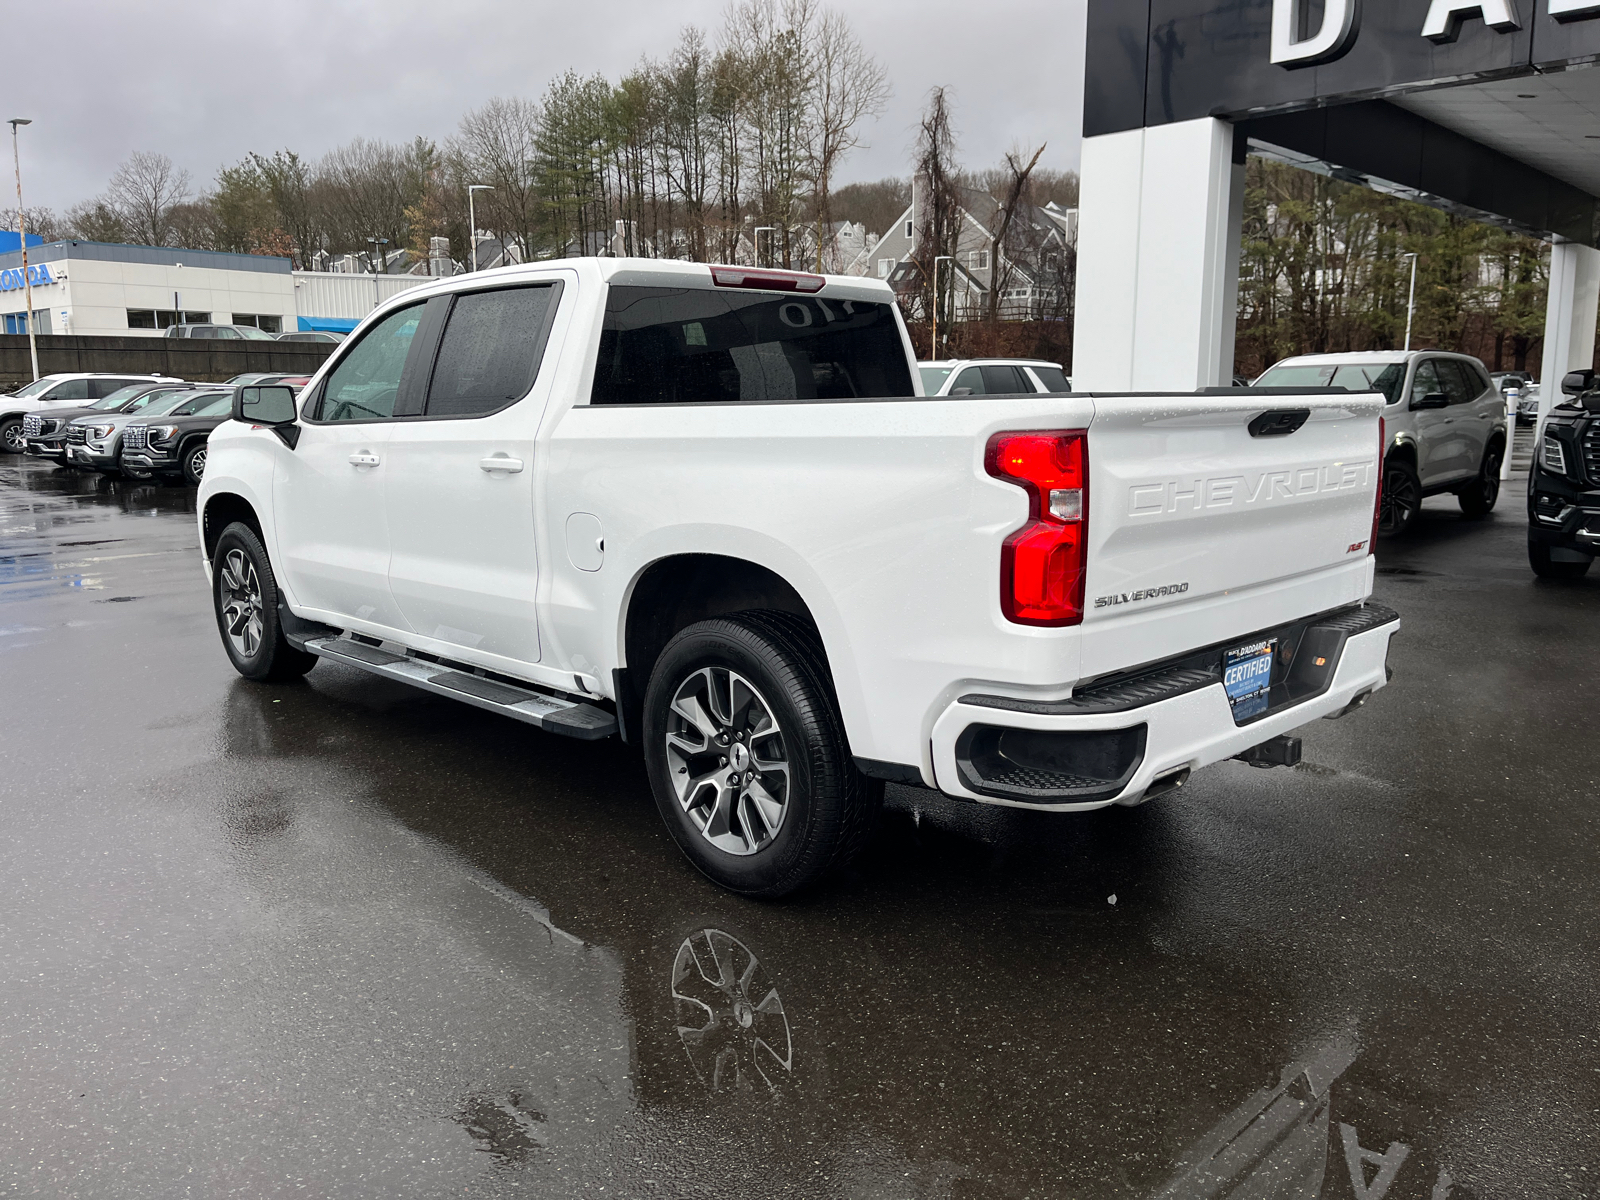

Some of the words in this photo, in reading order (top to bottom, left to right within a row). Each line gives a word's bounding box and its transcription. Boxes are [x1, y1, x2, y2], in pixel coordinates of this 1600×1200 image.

[0, 264, 53, 291] ONDA
[1128, 460, 1375, 516] CHEVROLET
[1345, 539, 1369, 554] RST
[1094, 582, 1189, 608] SILVERADO
[1224, 656, 1271, 686] CERTIFIED
